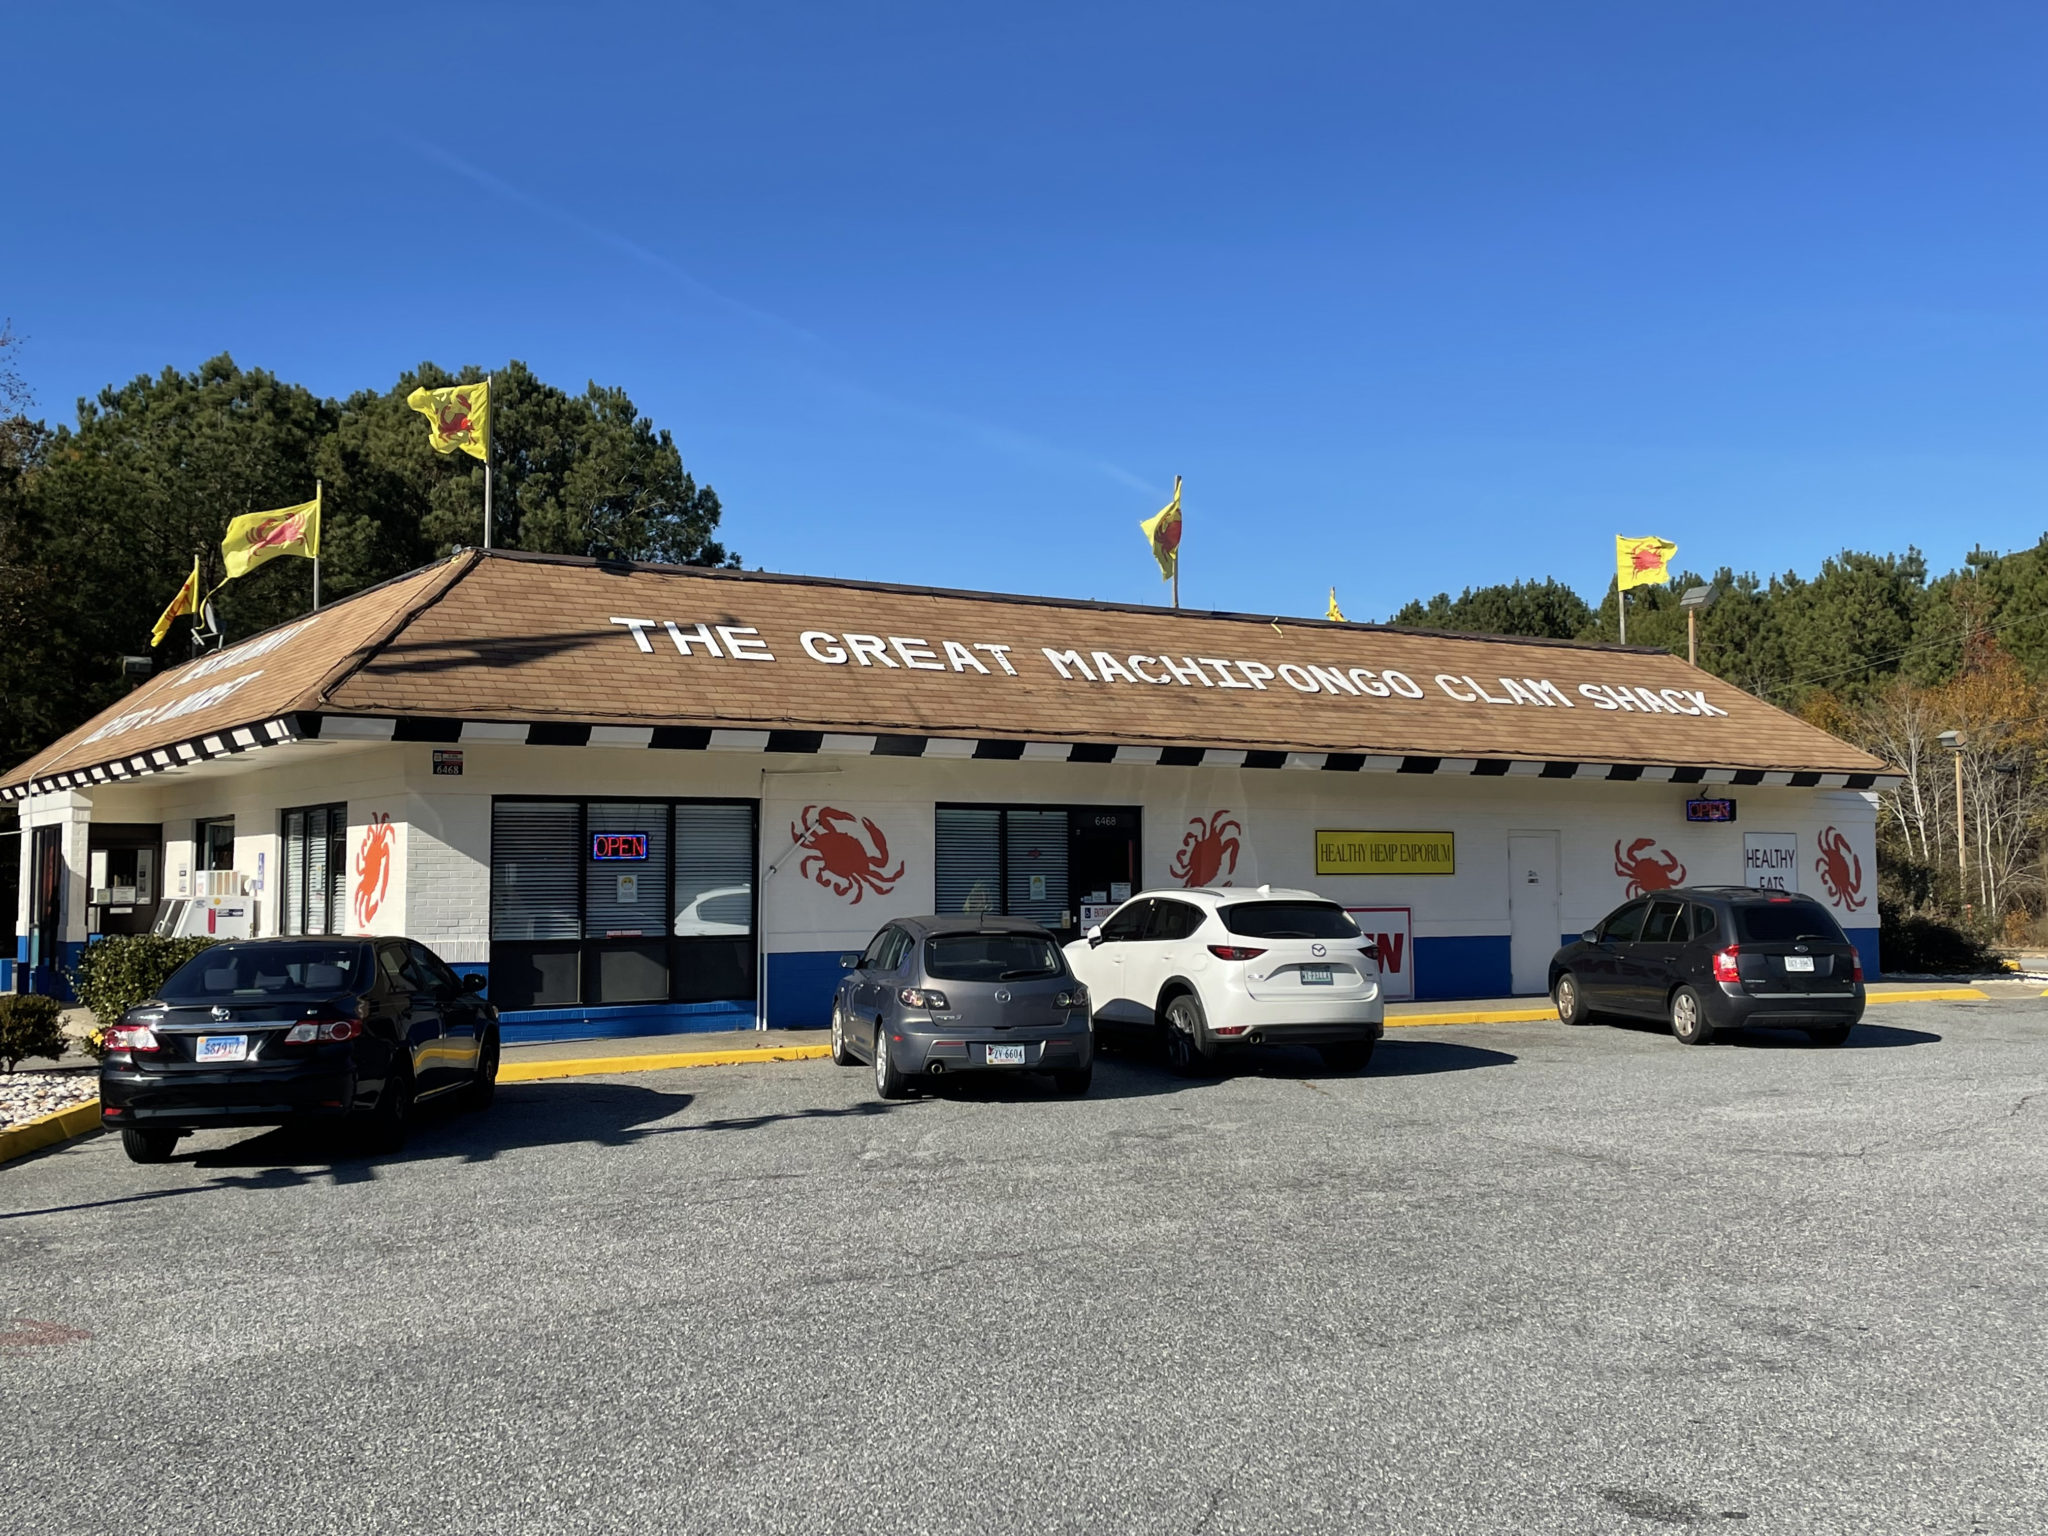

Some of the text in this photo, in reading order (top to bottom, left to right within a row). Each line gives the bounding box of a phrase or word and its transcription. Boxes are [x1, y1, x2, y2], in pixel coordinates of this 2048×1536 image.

[610, 617, 1729, 717] THE GREAT MACHIPONGO CLAM SHACK
[436, 765, 460, 774] 6468
[1690, 803, 1729, 818] OPEN
[1094, 816, 1117, 826] 6468
[595, 836, 645, 857] OPEN
[1320, 843, 1451, 862] HEALTHY HEMP EMPORIUM
[1746, 849, 1795, 869] HEALTHY
[1759, 876, 1785, 889] EATS
